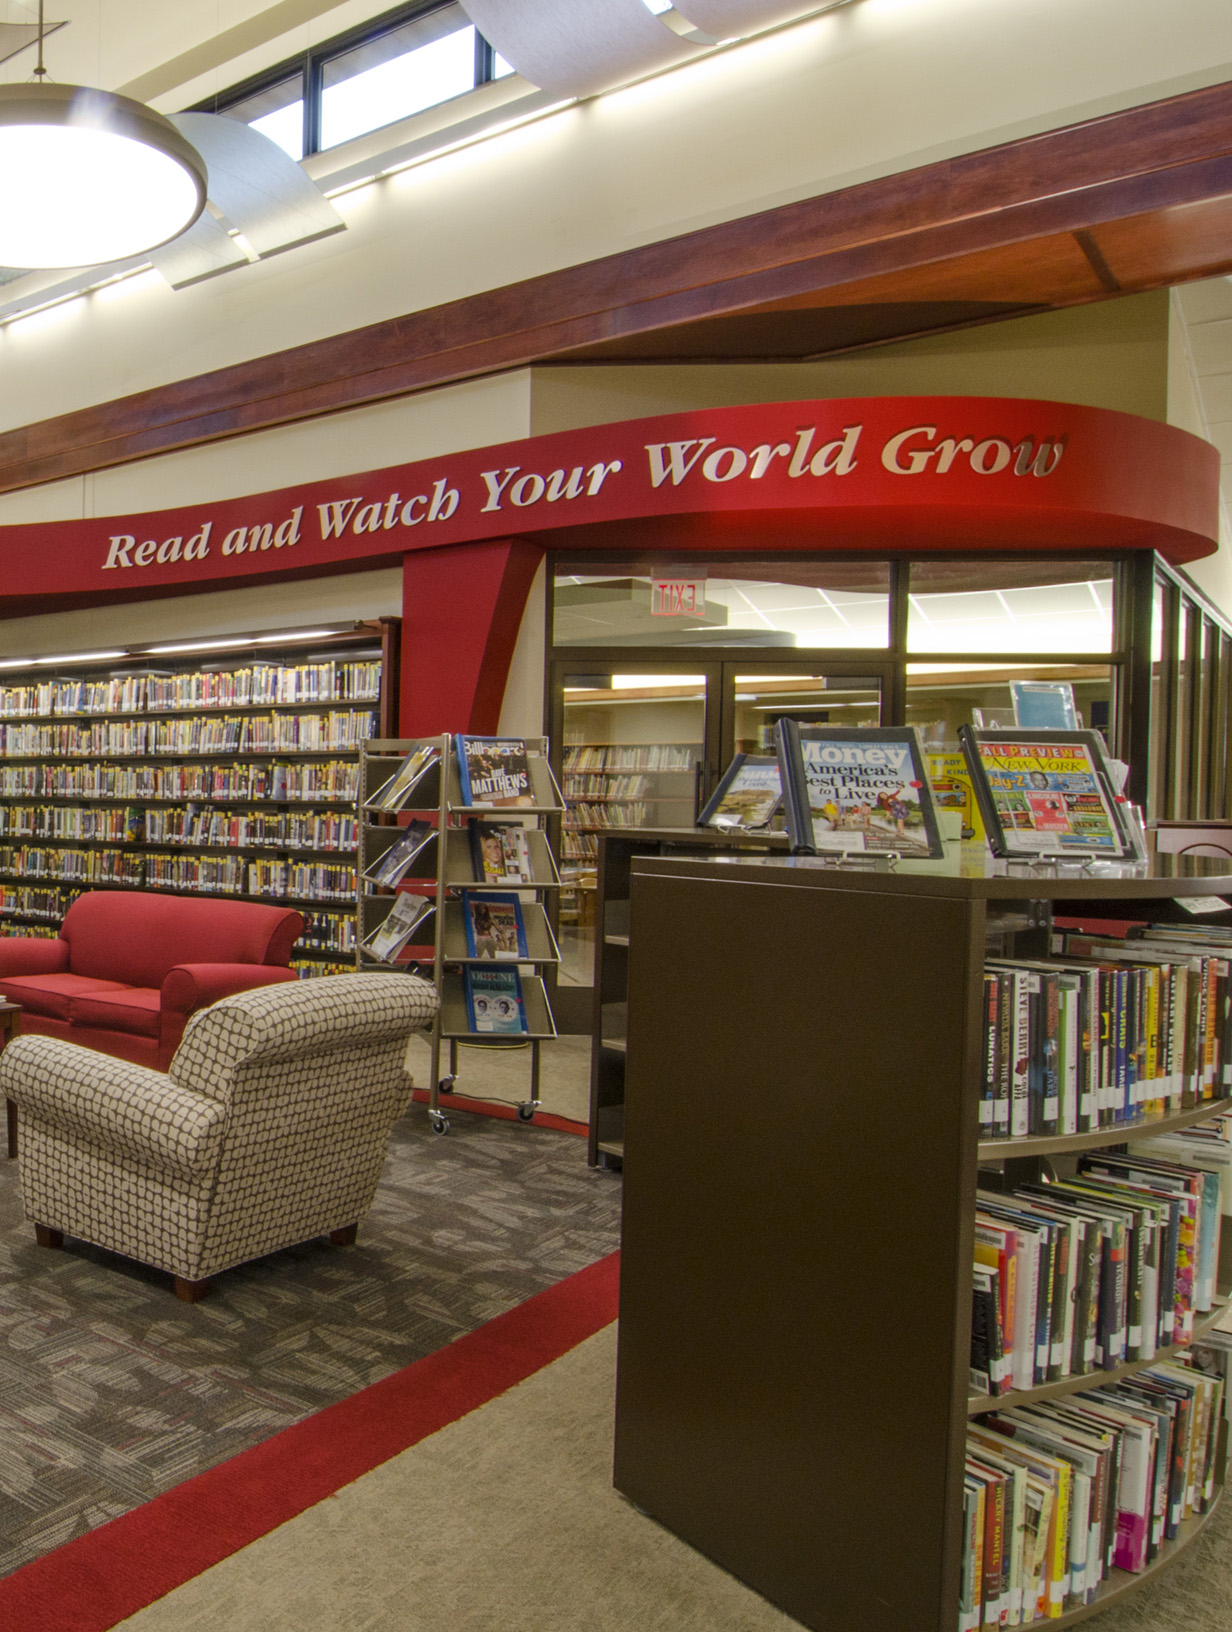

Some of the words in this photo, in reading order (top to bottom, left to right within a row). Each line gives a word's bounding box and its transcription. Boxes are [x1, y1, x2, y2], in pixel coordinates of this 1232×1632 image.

[101, 521, 213, 570] Read
[221, 505, 304, 556] and
[316, 477, 461, 540] Watch
[480, 459, 622, 513] Your
[644, 424, 864, 488] World
[881, 425, 1065, 477] Grow
[805, 761, 899, 777] America's
[1010, 746, 1074, 758] PREVIEW
[471, 772, 528, 795] MATTHEWS
[805, 775, 838, 787] est
[841, 775, 906, 789] Places
[818, 787, 832, 796] to
[834, 787, 876, 800] Live
[988, 774, 1027, 790] Jay-Z
[1001, 992, 1010, 1029] NEVADA
[1018, 977, 1028, 1016] STEVE
[1119, 1010, 1127, 1049] CRAIS
[1200, 998, 1208, 1032] FLYNN
[987, 1026, 996, 1083] LUNATICS
[1001, 1031, 1010, 1055] BARR
[1018, 1018, 1028, 1056] BERRY
[995, 1487, 1003, 1523] HILARY
[992, 1525, 1001, 1565] MANTEL
